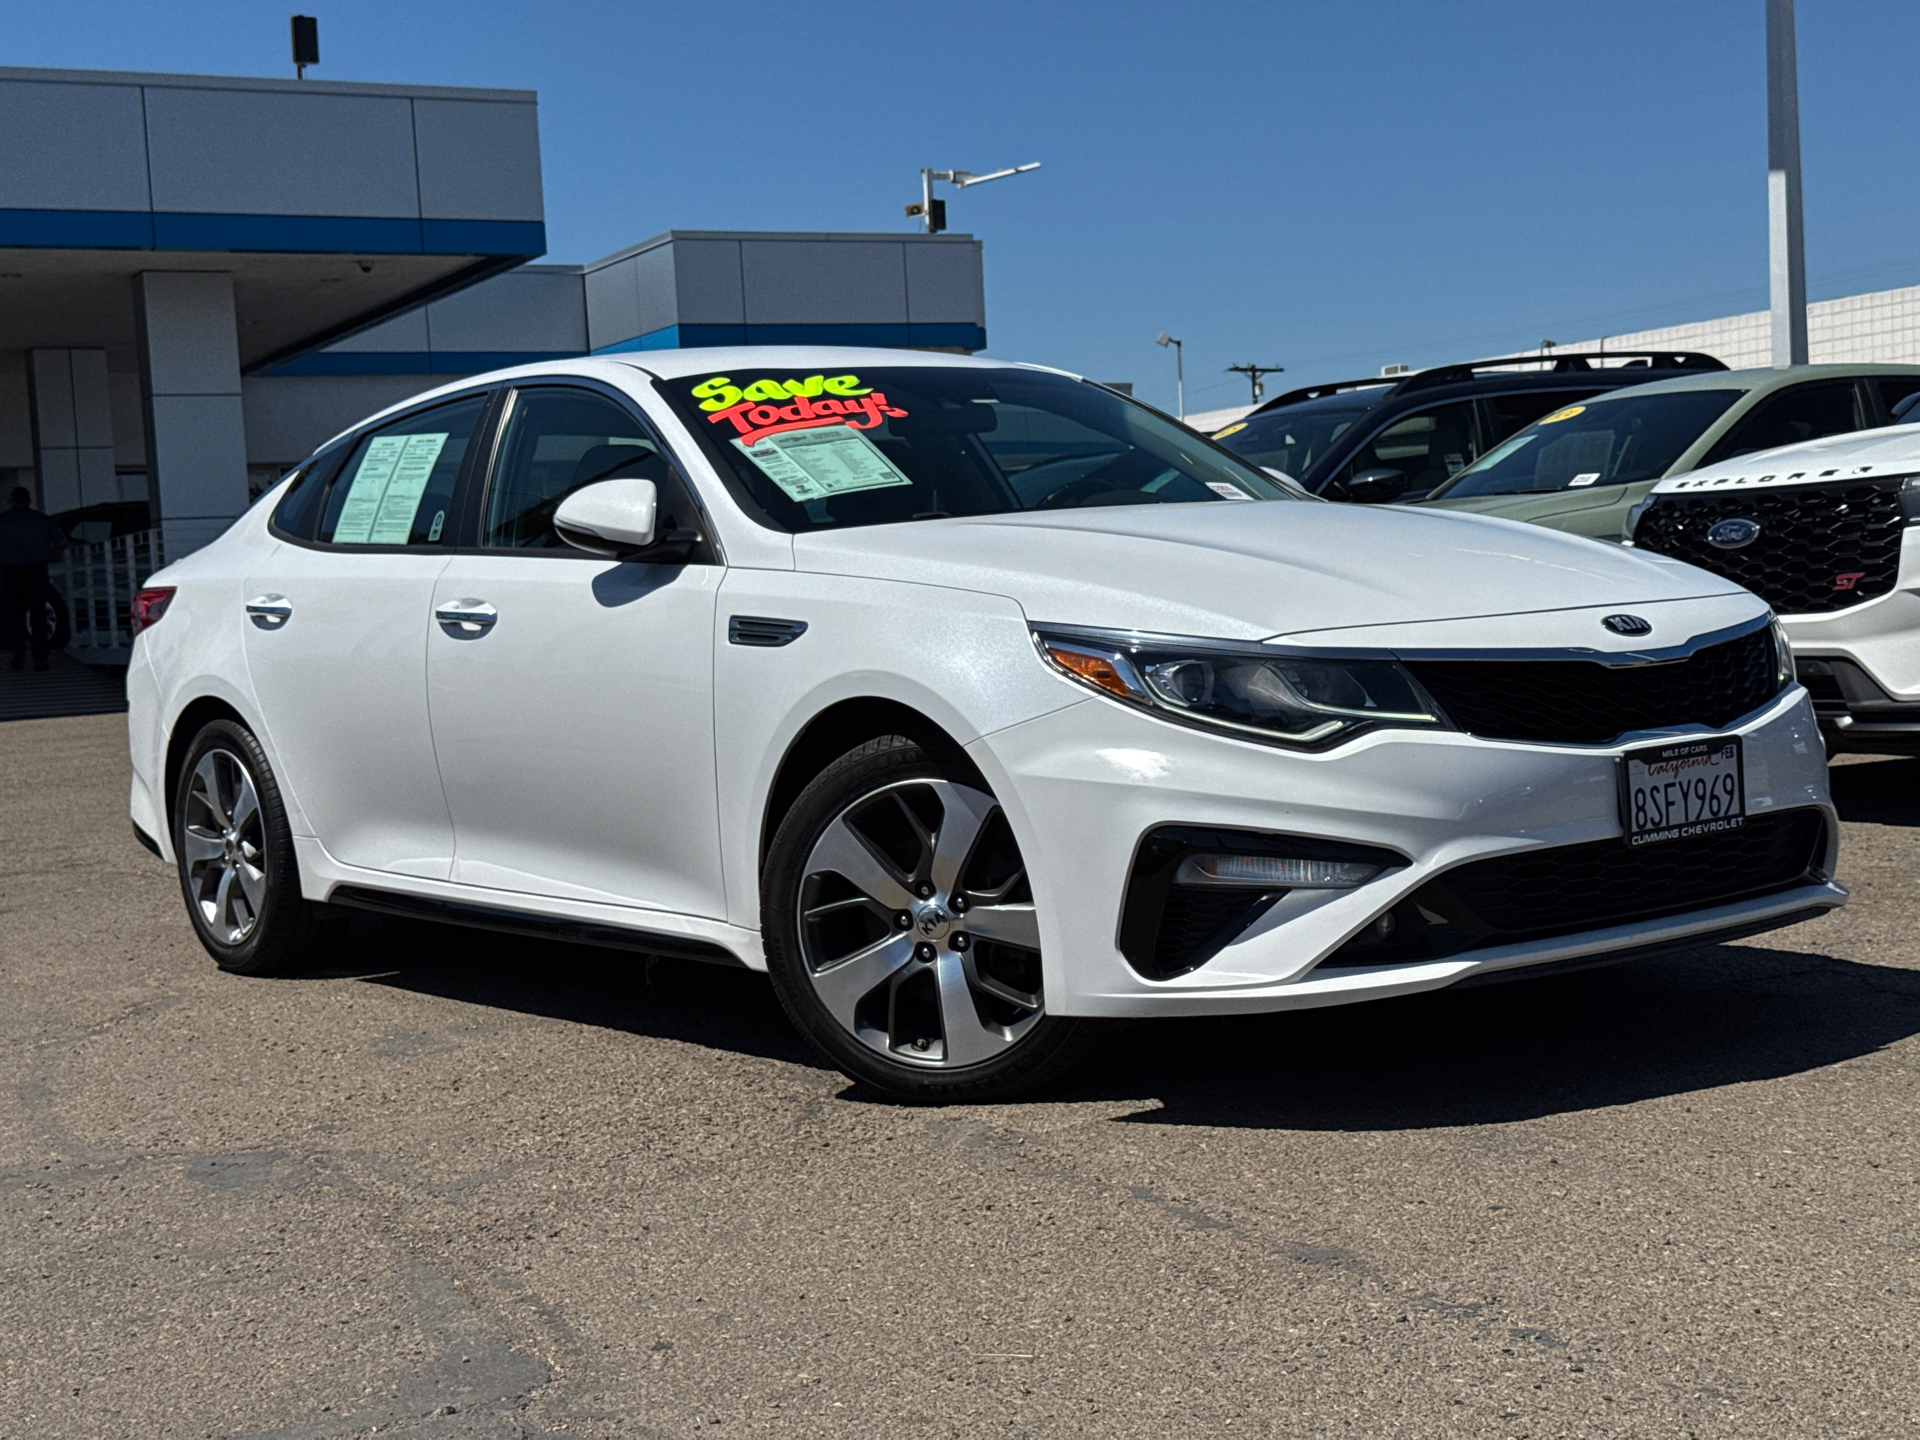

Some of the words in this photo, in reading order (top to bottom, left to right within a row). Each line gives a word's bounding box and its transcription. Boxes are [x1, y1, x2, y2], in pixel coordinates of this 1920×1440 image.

[691, 374, 875, 412] Save
[707, 392, 909, 435] Today!
[1675, 465, 1874, 489] EXPLORER
[1715, 523, 1745, 542] Ford
[1832, 572, 1866, 591] ST
[1607, 616, 1649, 631] KIA
[1661, 747, 1680, 758] MILE
[1680, 746, 1690, 755] OF
[1690, 745, 1708, 753] CARS
[1720, 746, 1735, 760] FEB
[1647, 755, 1720, 779] California
[1634, 773, 1735, 830] 8SFY969
[1631, 828, 1679, 846] CUMMING
[1681, 817, 1744, 837] CHEVROLET
[921, 912, 946, 935] KIA
